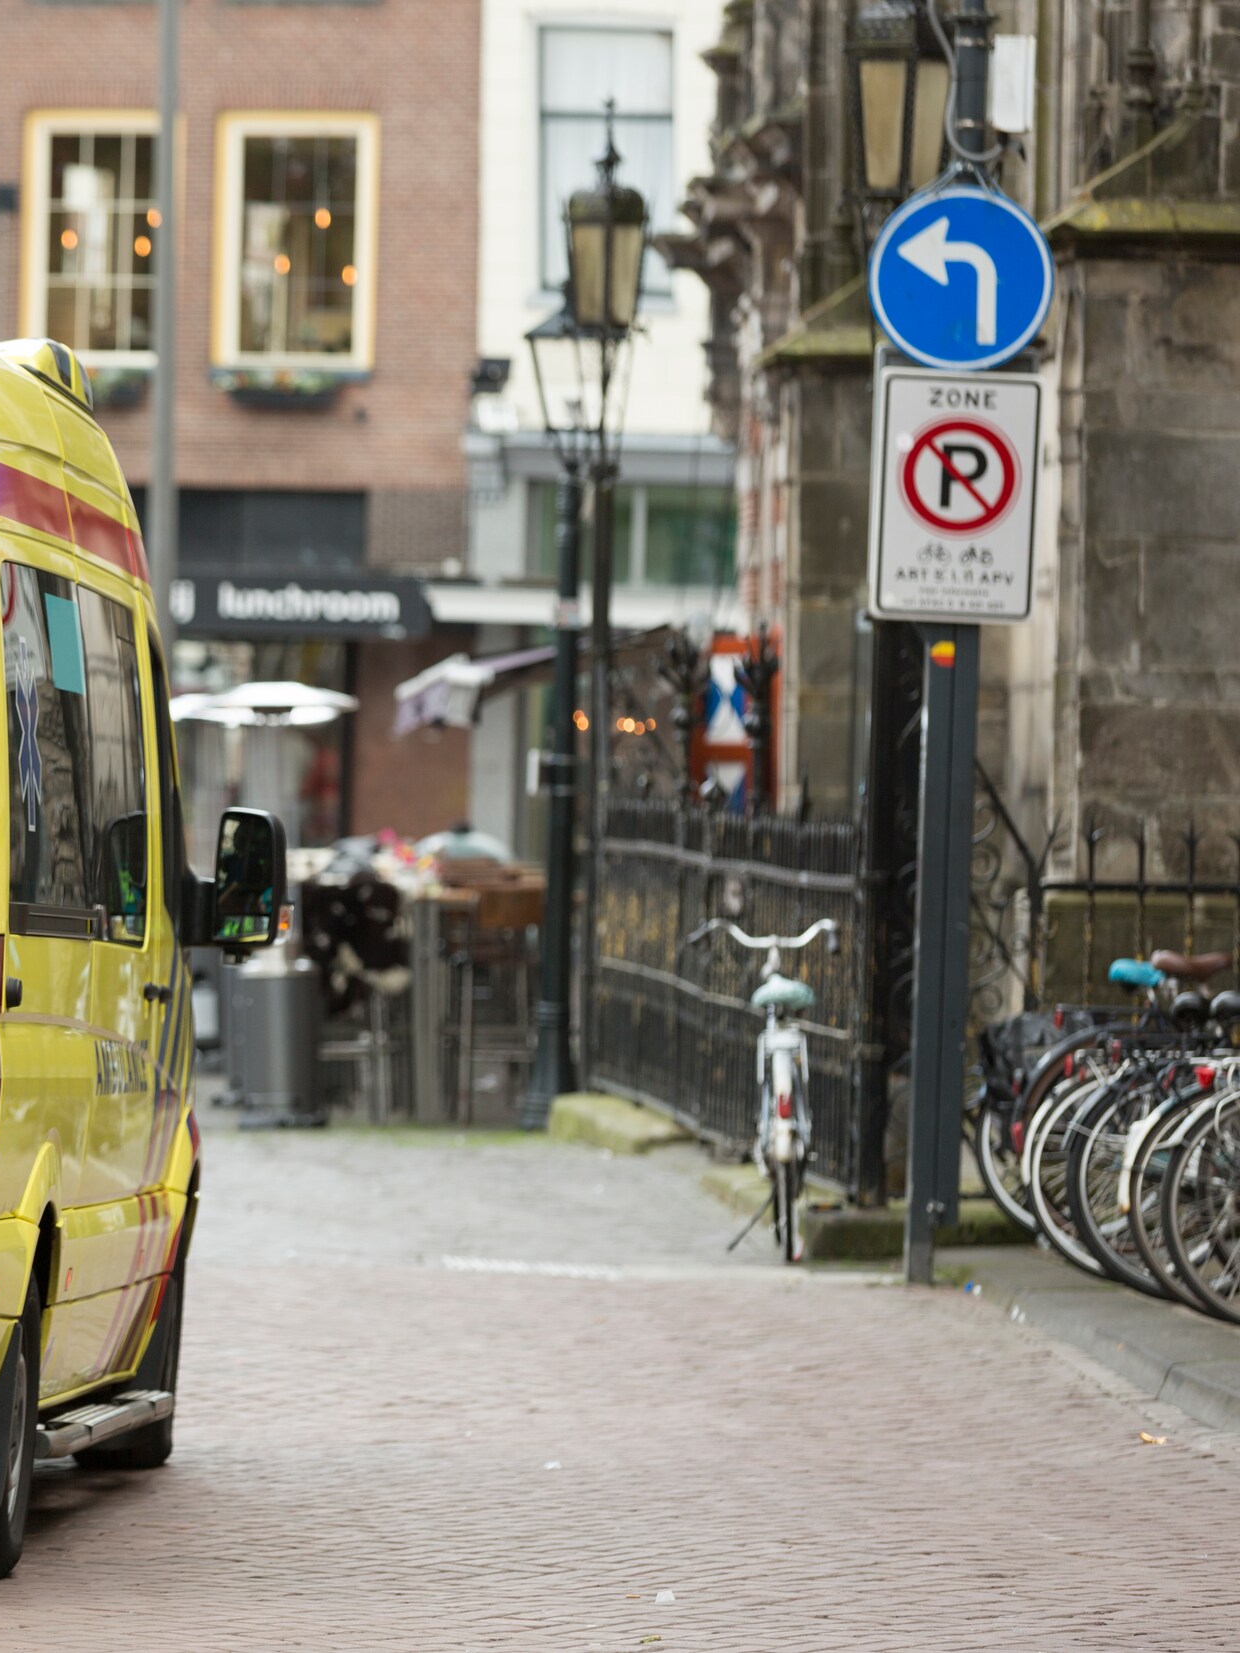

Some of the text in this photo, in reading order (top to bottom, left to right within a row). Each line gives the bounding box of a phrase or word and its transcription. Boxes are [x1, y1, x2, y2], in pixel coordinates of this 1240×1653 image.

[929, 386, 997, 410] ZONE
[940, 443, 988, 508] P
[217, 580, 400, 622] lunchroom
[94, 1040, 148, 1096] AMBULANCE
